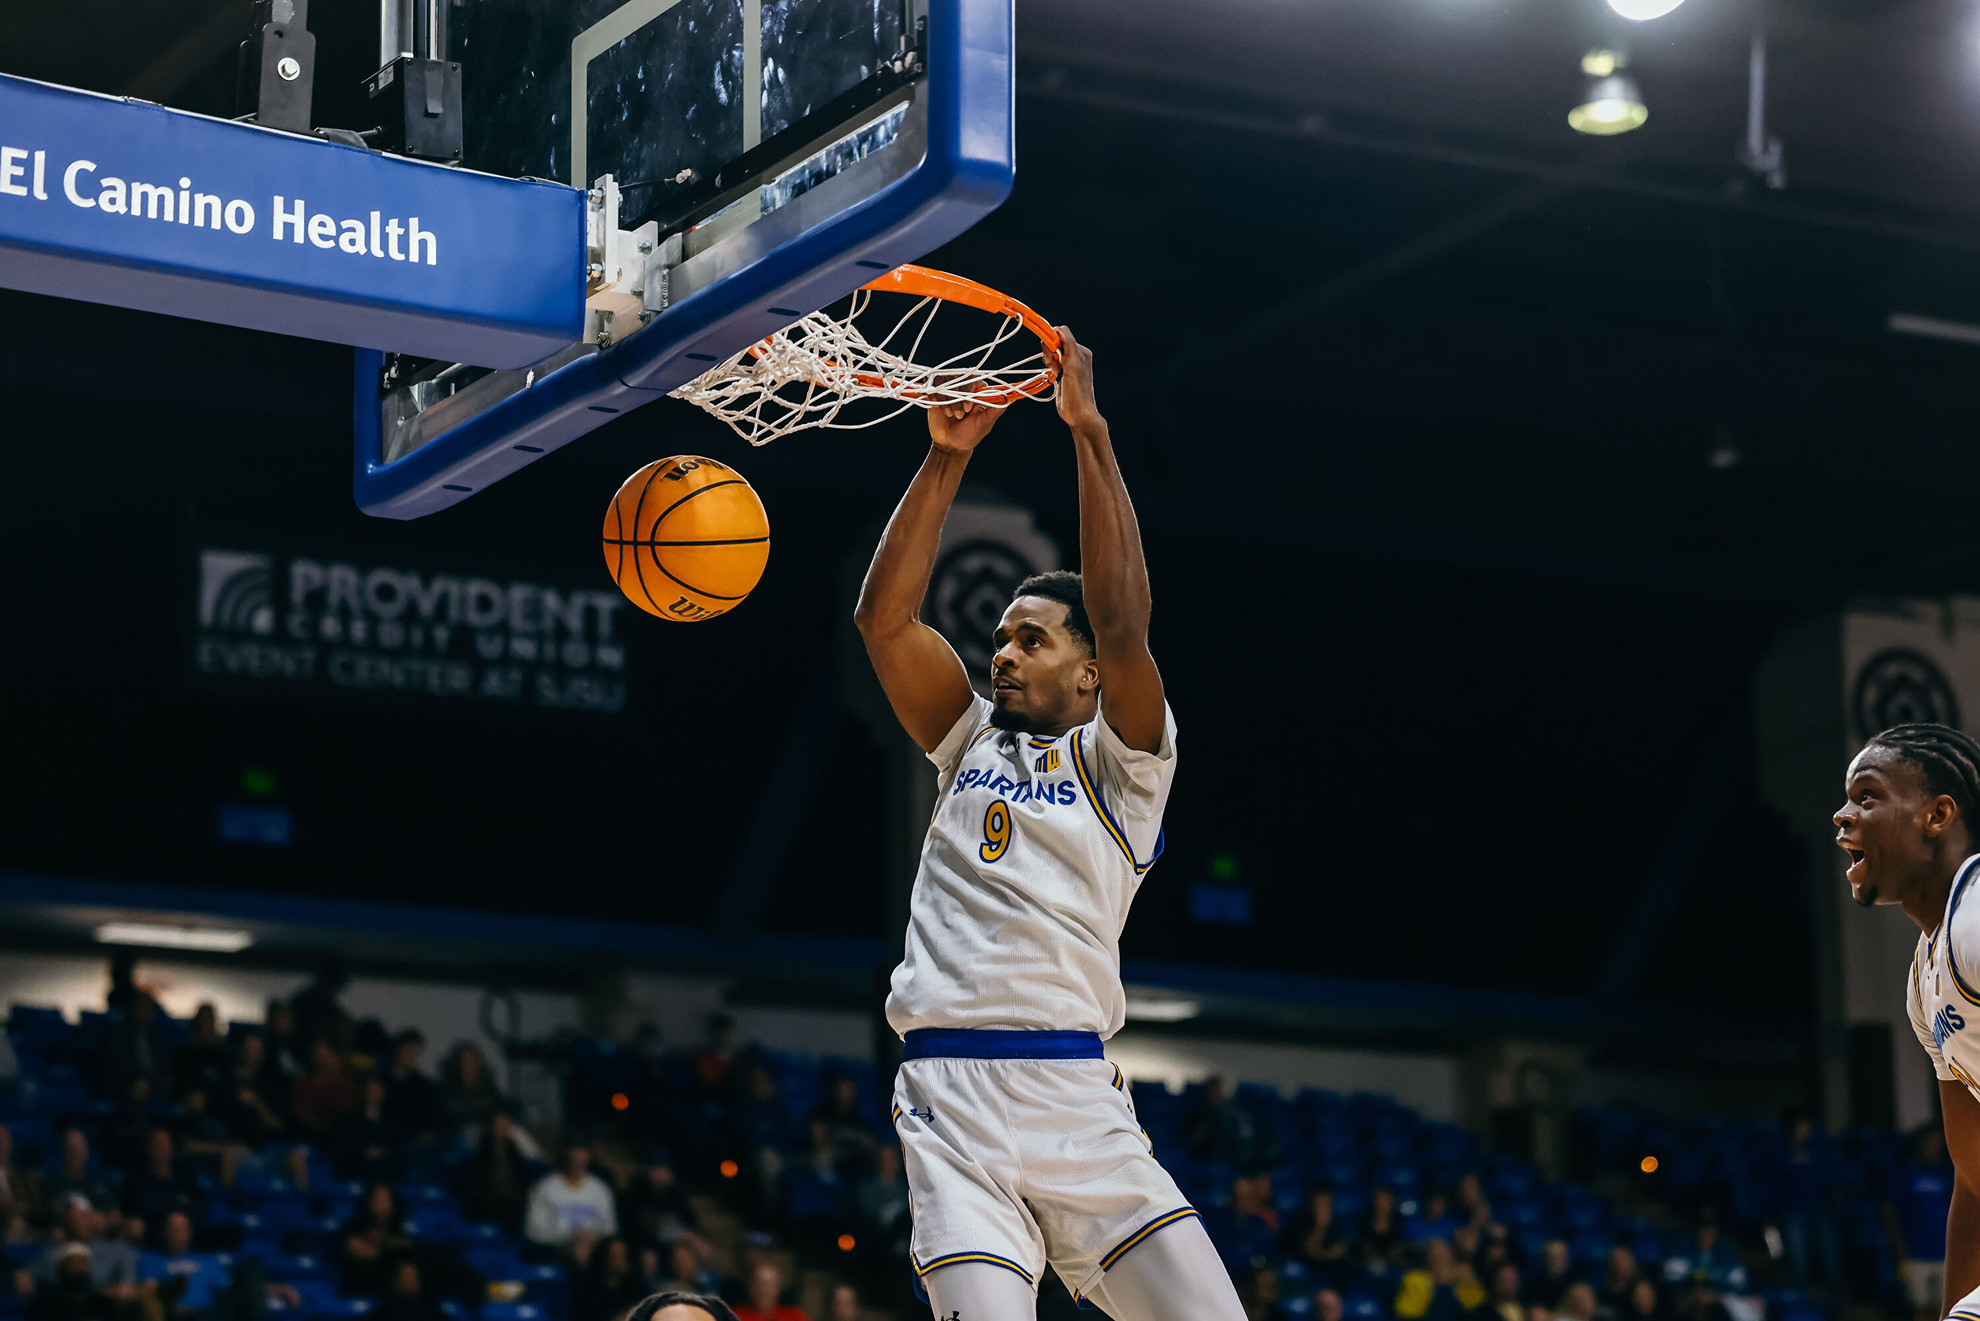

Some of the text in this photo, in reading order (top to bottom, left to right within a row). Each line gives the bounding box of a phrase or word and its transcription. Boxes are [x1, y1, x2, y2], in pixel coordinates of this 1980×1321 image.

[1, 146, 437, 265] El Camino Health
[290, 557, 623, 640] PROVIDENT
[198, 640, 316, 680] EVENT
[327, 650, 473, 696] CENTER
[288, 610, 625, 671] CREDIT UNION
[953, 769, 1077, 806] SPARTANS
[979, 799, 1012, 863] 9
